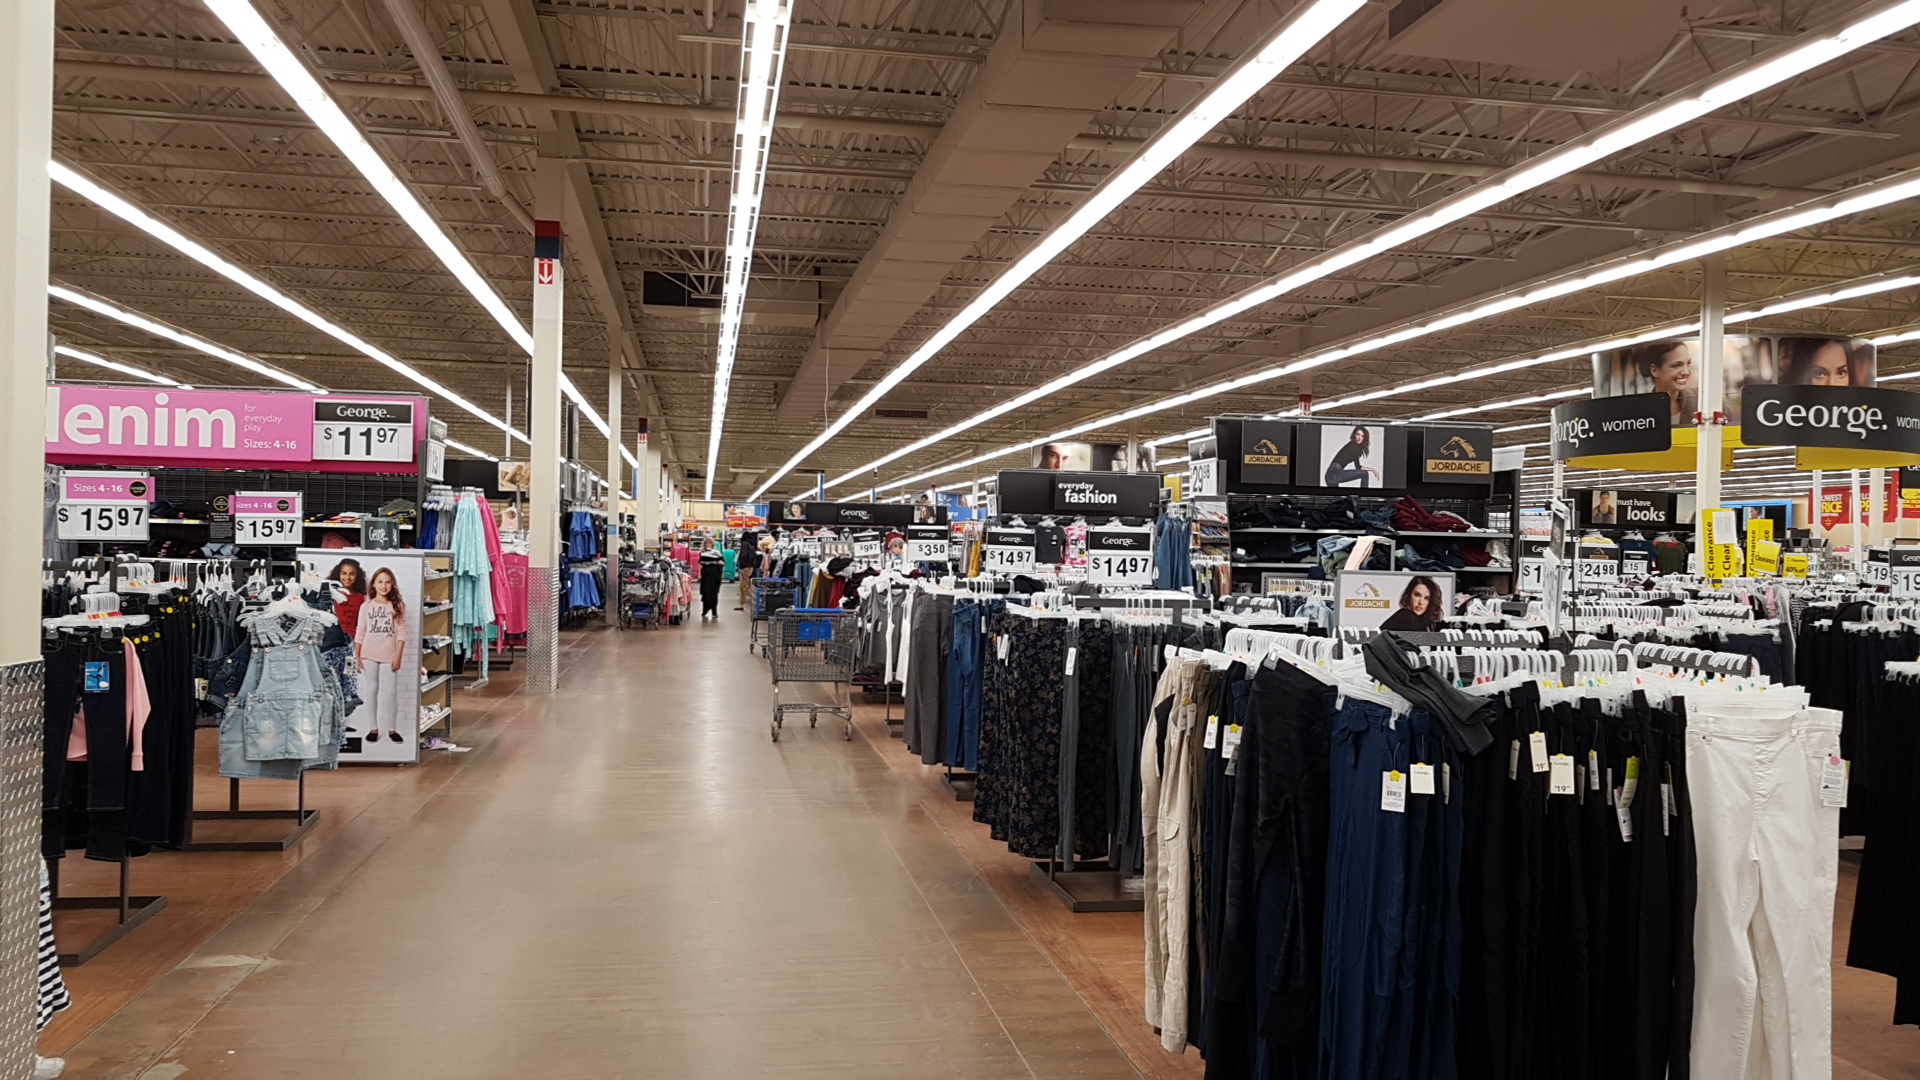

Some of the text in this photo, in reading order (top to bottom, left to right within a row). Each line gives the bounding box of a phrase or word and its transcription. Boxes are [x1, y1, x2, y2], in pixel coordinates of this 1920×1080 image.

[244, 404, 256, 413] for
[244, 415, 282, 424] everyday
[1756, 399, 1920, 439] George. wom
[244, 423, 262, 433] play
[1602, 417, 1656, 432] women
[243, 438, 272, 449] Sizes:
[1247, 455, 1283, 464] JORDACHE
[1431, 461, 1482, 472] JORDACHE
[73, 483, 97, 492] Sizes
[1058, 482, 1094, 491] everyday
[1064, 489, 1118, 505] fashion
[236, 501, 252, 509] Sizes
[1633, 499, 1652, 507] have
[1821, 501, 1843, 513] RICE
[1626, 505, 1666, 522] looks
[1706, 521, 1715, 571] Clearance
[1722, 544, 1732, 571] Clear
[1349, 599, 1385, 608] JORDACHE
